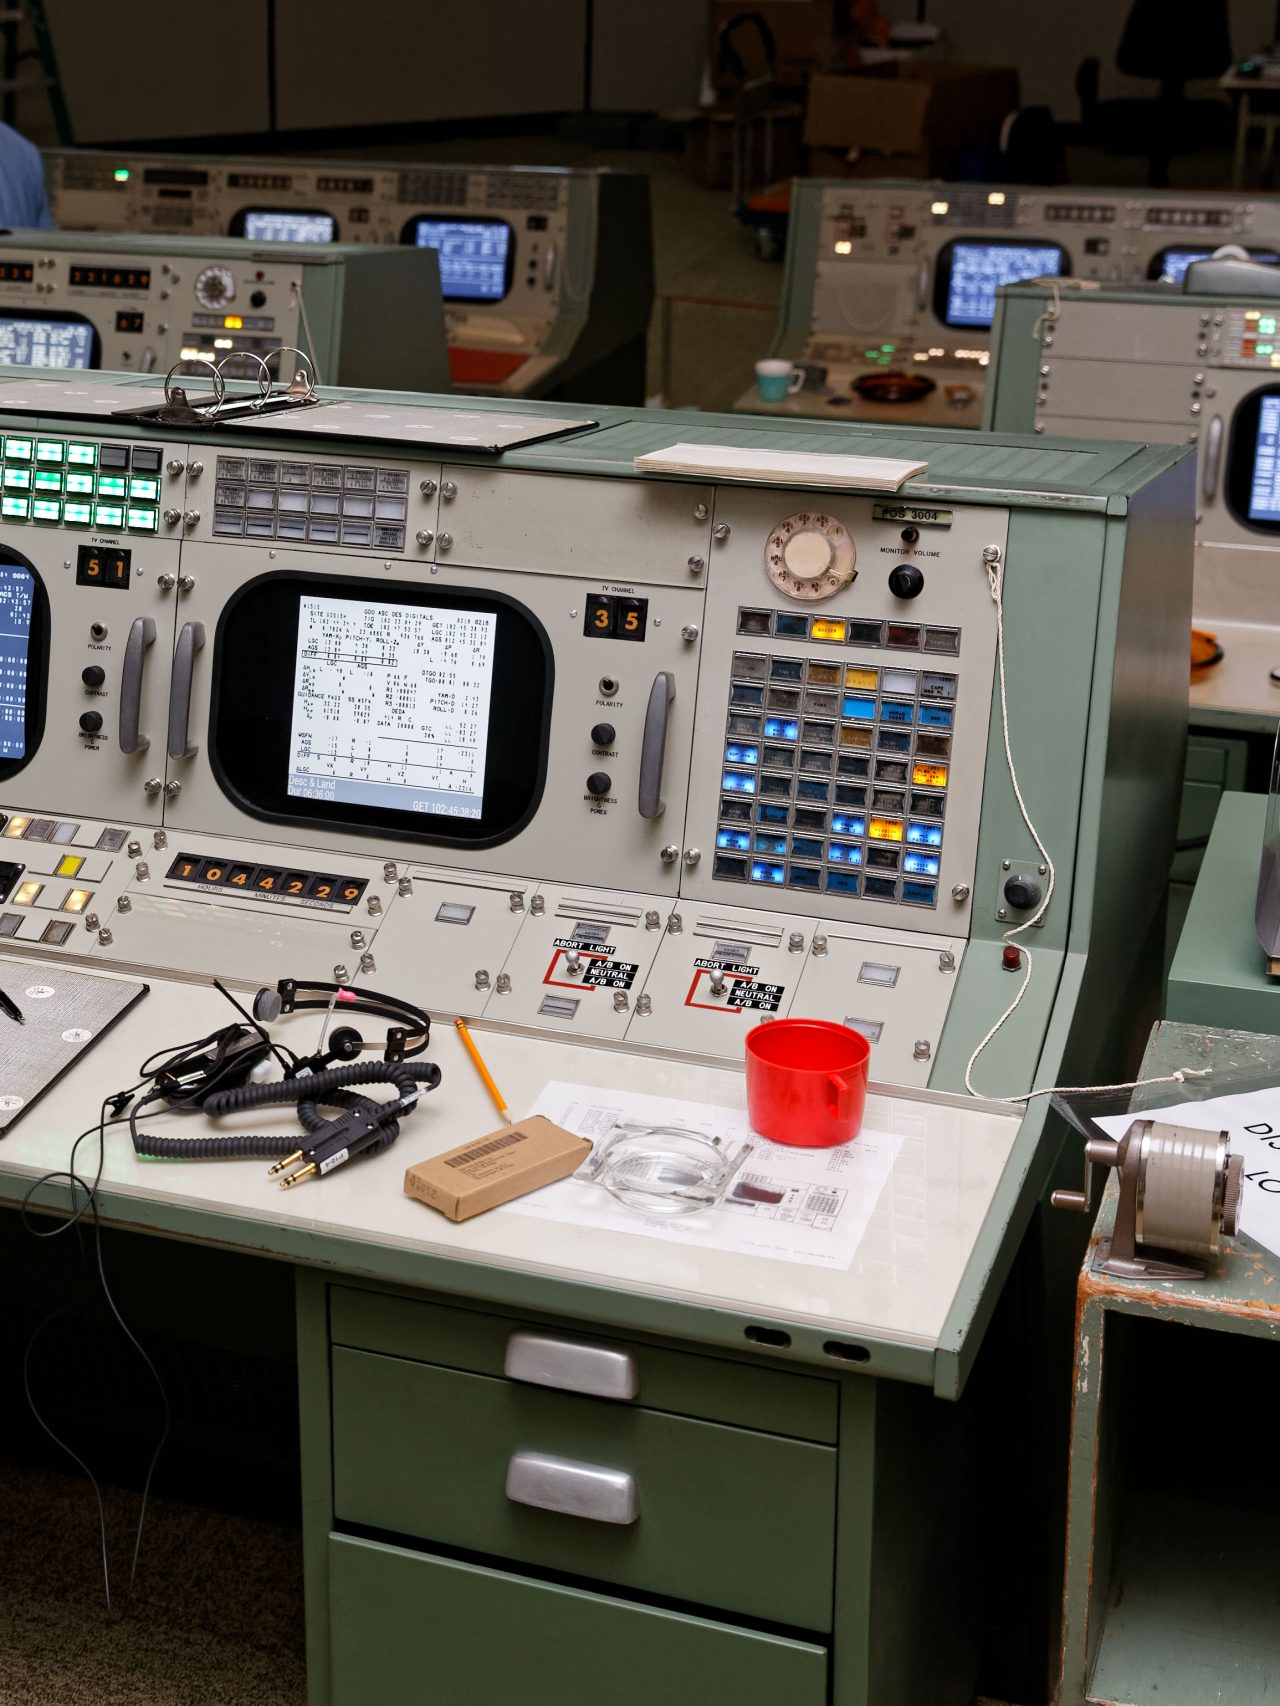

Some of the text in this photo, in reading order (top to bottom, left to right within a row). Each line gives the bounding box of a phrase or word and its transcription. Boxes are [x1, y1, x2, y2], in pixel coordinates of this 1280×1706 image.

[882, 507, 938, 521] POS 3004
[879, 547, 941, 558] MONITOR VOLUME
[611, 586, 635, 594] CHANNEL
[405, 612, 433, 621] DIGITALS
[87, 643, 112, 652] POLARITY
[595, 699, 624, 708] POLARITY
[84, 744, 100, 752] POWER
[591, 749, 619, 758] CONTRAST
[289, 774, 336, 790] Desc & Land
[288, 784, 302, 796] Dur
[583, 794, 618, 805] BRIGHTNESS
[412, 800, 430, 812] GET
[197, 883, 224, 893] HOURS
[254, 892, 286, 902] MINUTES
[300, 899, 335, 909] SECONDS
[554, 939, 616, 954] ABORT LIGHT
[595, 960, 632, 971] A/B ON
[694, 959, 759, 975] ABORT LIGHT
[590, 968, 629, 980] NEUTRAL
[589, 977, 625, 988] A/B ON
[740, 981, 778, 993] A/B ON
[735, 989, 775, 1002] NEUTRAL
[734, 999, 772, 1010] A/B ON
